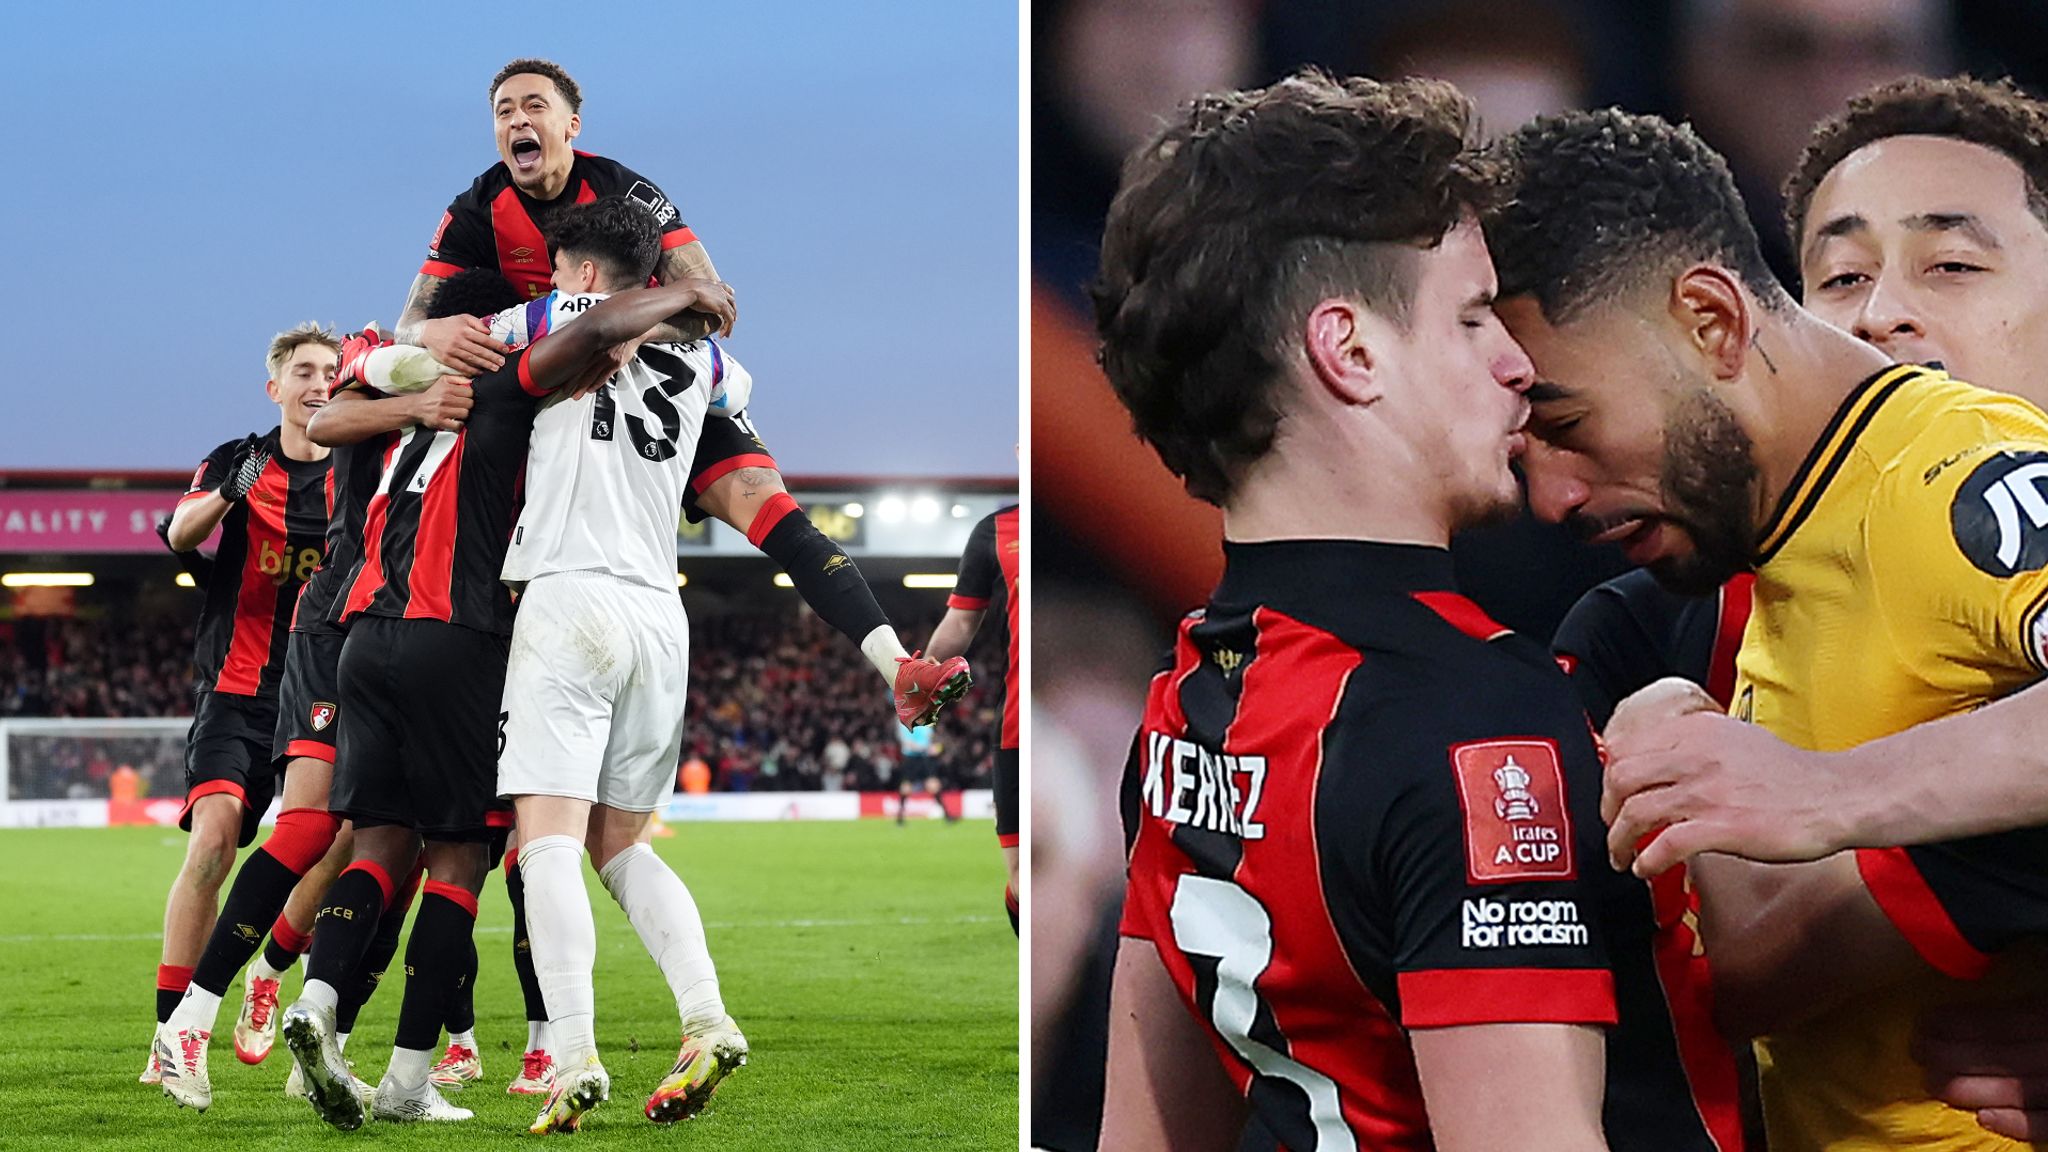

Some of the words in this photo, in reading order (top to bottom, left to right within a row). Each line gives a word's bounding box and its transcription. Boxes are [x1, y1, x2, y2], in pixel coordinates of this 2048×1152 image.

[0, 509, 108, 534] ALITY
[1516, 843, 1560, 862] CUP
[1462, 897, 1506, 924] No
[1509, 900, 1578, 923] room
[1462, 921, 1503, 947] for
[1507, 921, 1588, 946] racism
